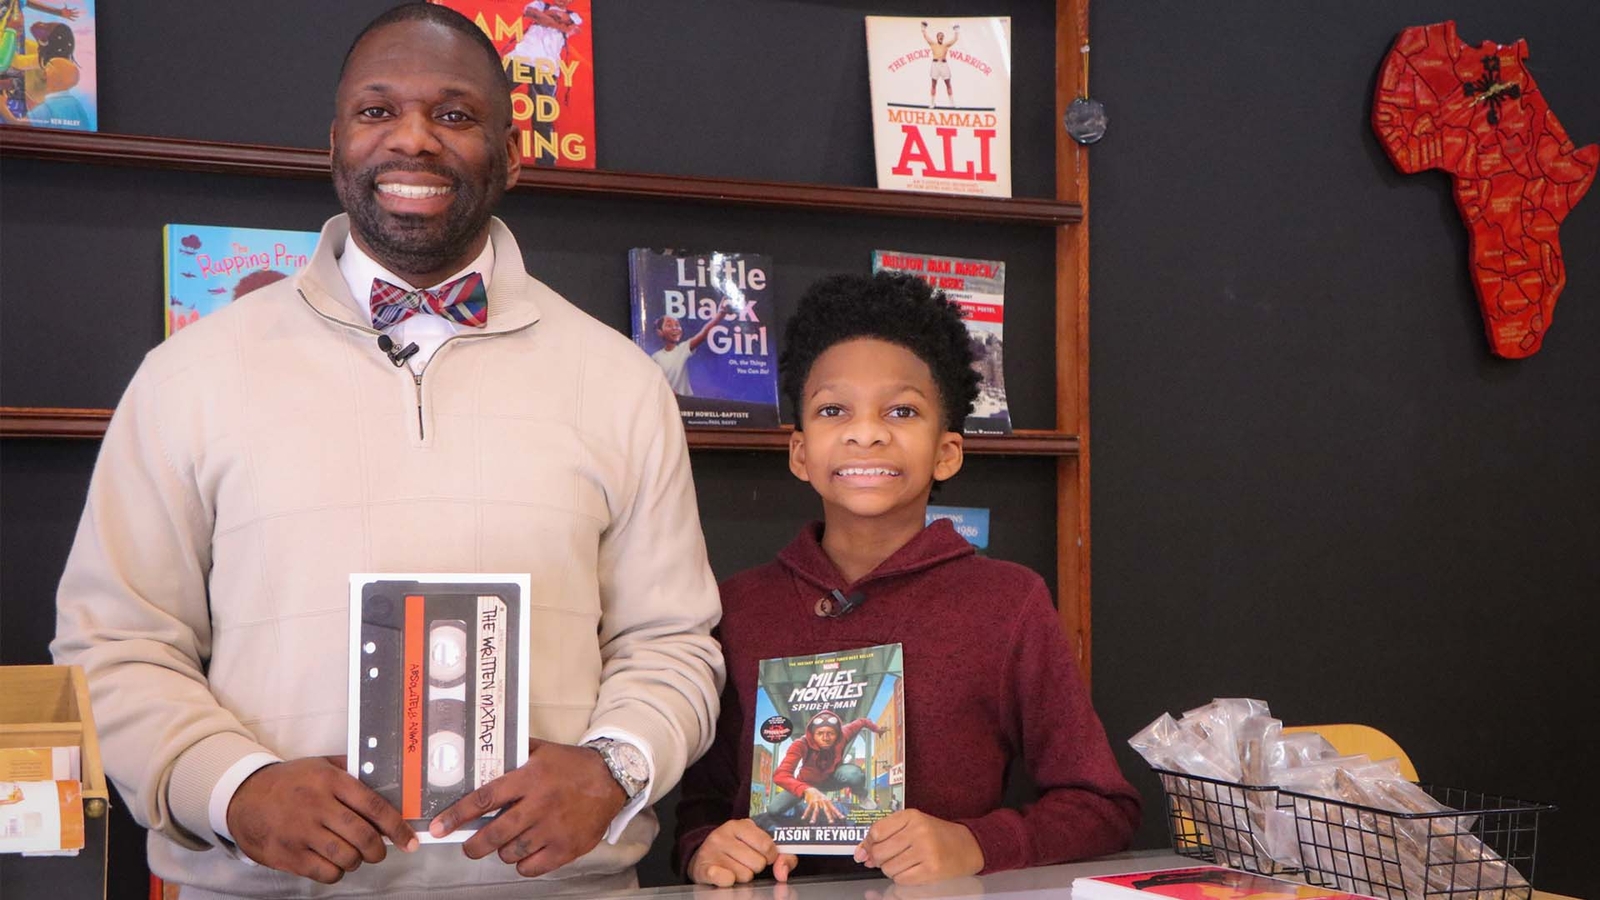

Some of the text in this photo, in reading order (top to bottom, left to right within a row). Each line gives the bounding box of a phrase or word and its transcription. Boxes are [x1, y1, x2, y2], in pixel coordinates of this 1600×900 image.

[474, 11, 524, 42] AM
[502, 56, 579, 87] ERY
[888, 49, 992, 76] THE HOLY WARRIOR
[511, 93, 560, 122] OD
[887, 109, 997, 128] MUHAMMAD
[522, 130, 586, 161] ING
[891, 125, 997, 182] ALI
[197, 243, 308, 280] Rapping Prin
[676, 258, 766, 291] Little
[927, 259, 951, 273] MAN
[664, 289, 760, 323] Black
[707, 326, 769, 356] Girl
[482, 606, 498, 633] THE
[480, 637, 497, 690] WRITTEN
[788, 682, 868, 702] MORALES
[807, 669, 857, 688] MILES
[791, 700, 858, 711] SPIDER-MAN
[773, 829, 810, 841] JASON
